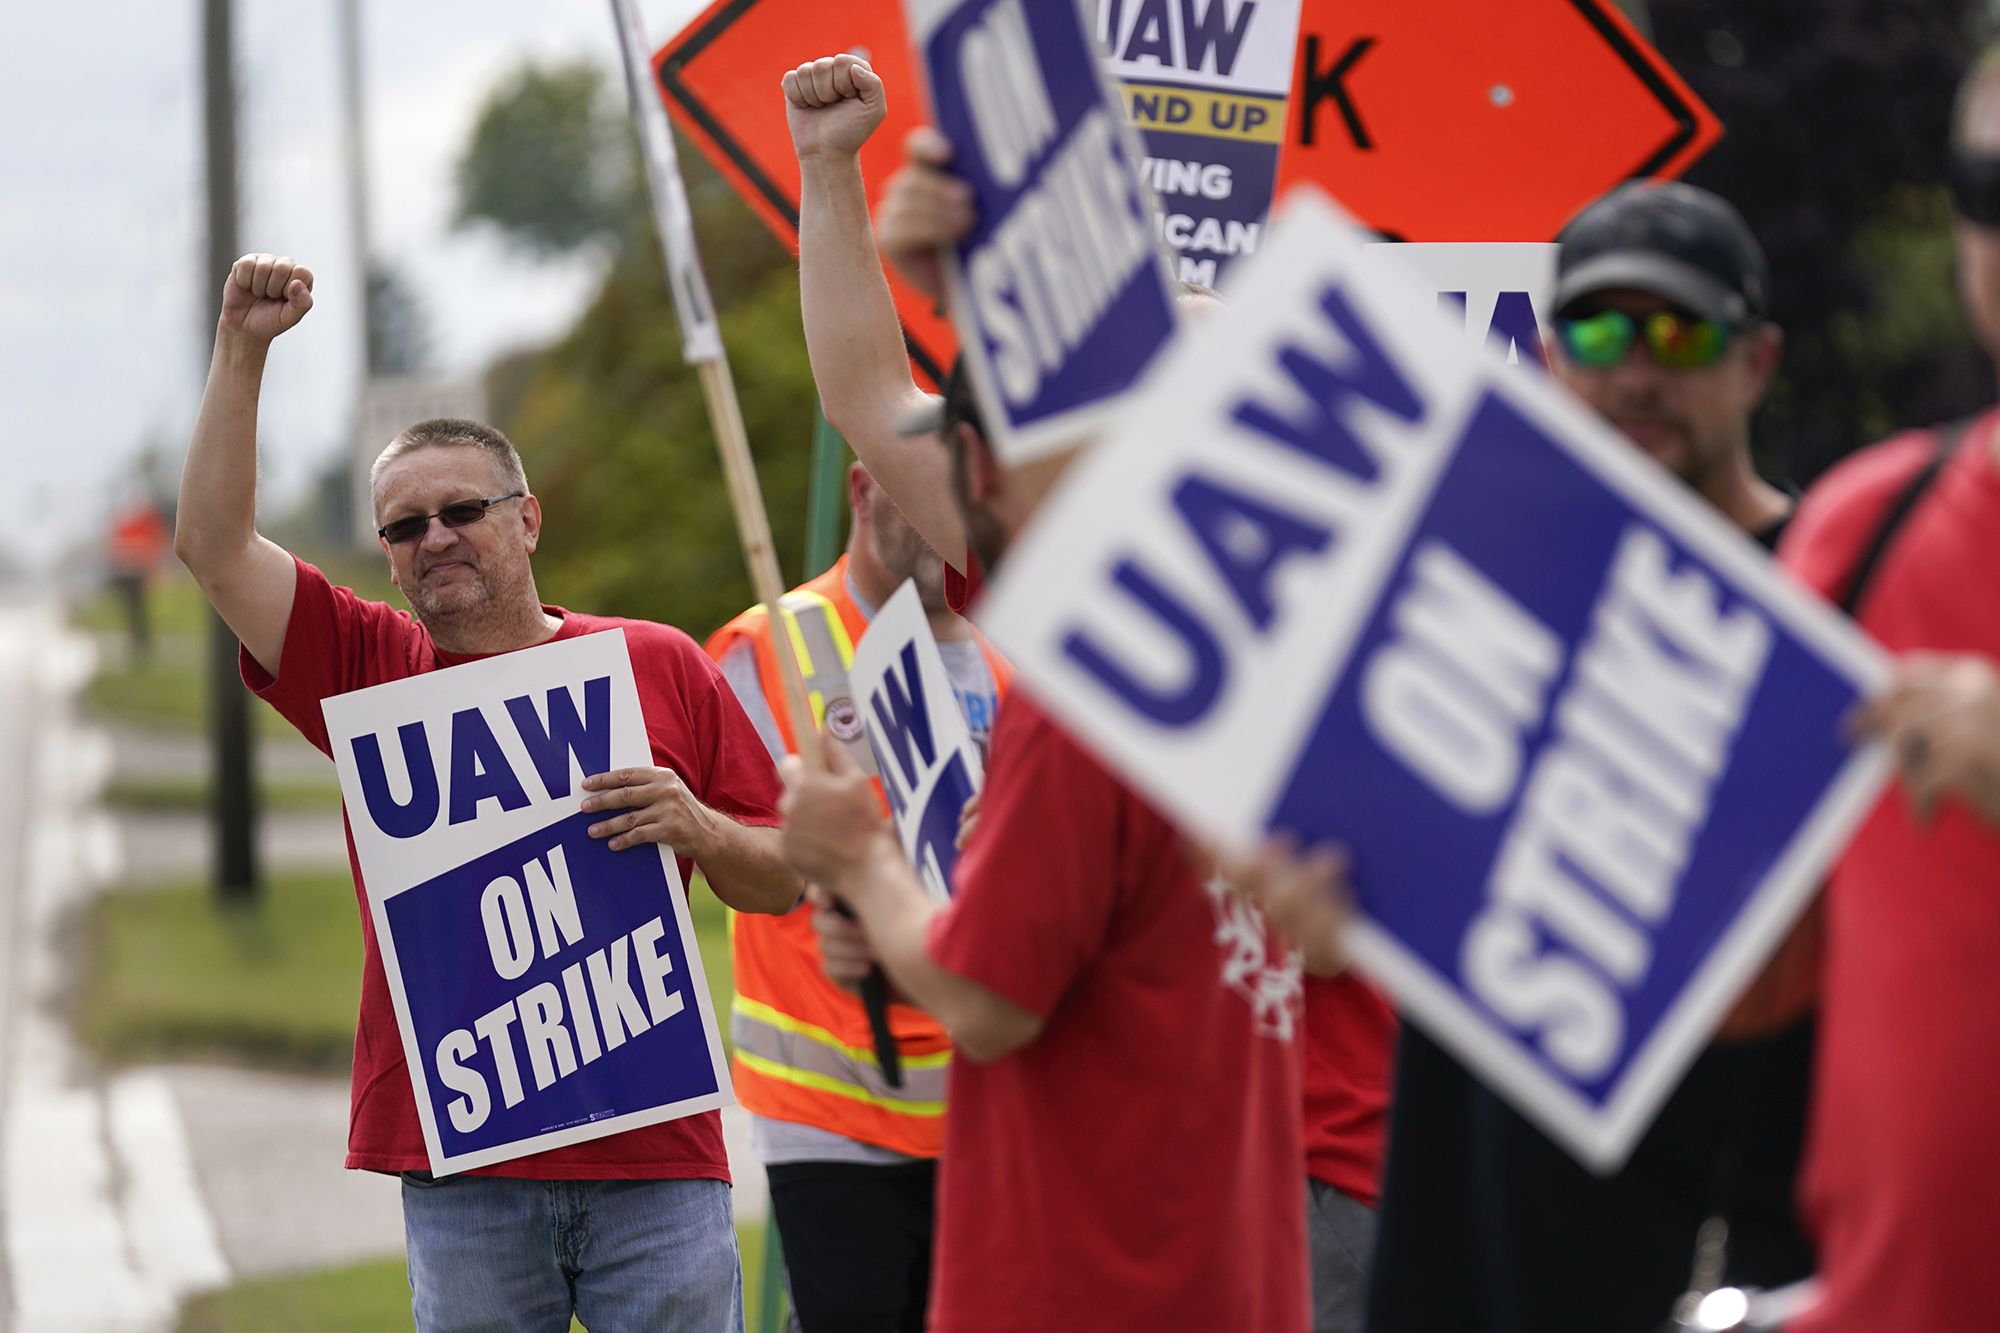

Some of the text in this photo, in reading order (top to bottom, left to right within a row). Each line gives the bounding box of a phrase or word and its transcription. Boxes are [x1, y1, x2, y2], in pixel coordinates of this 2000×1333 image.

[1110, 0, 1256, 76] AW
[1131, 93, 1268, 131] ND UP
[1298, 35, 1375, 150] K
[1177, 256, 1217, 288] M
[1062, 280, 1430, 730] UAW
[1360, 542, 1563, 815] ON
[350, 675, 611, 838] UAW
[1458, 527, 1775, 1080] STRIKE
[480, 843, 585, 981] ON
[435, 915, 685, 1133] STRIKE
